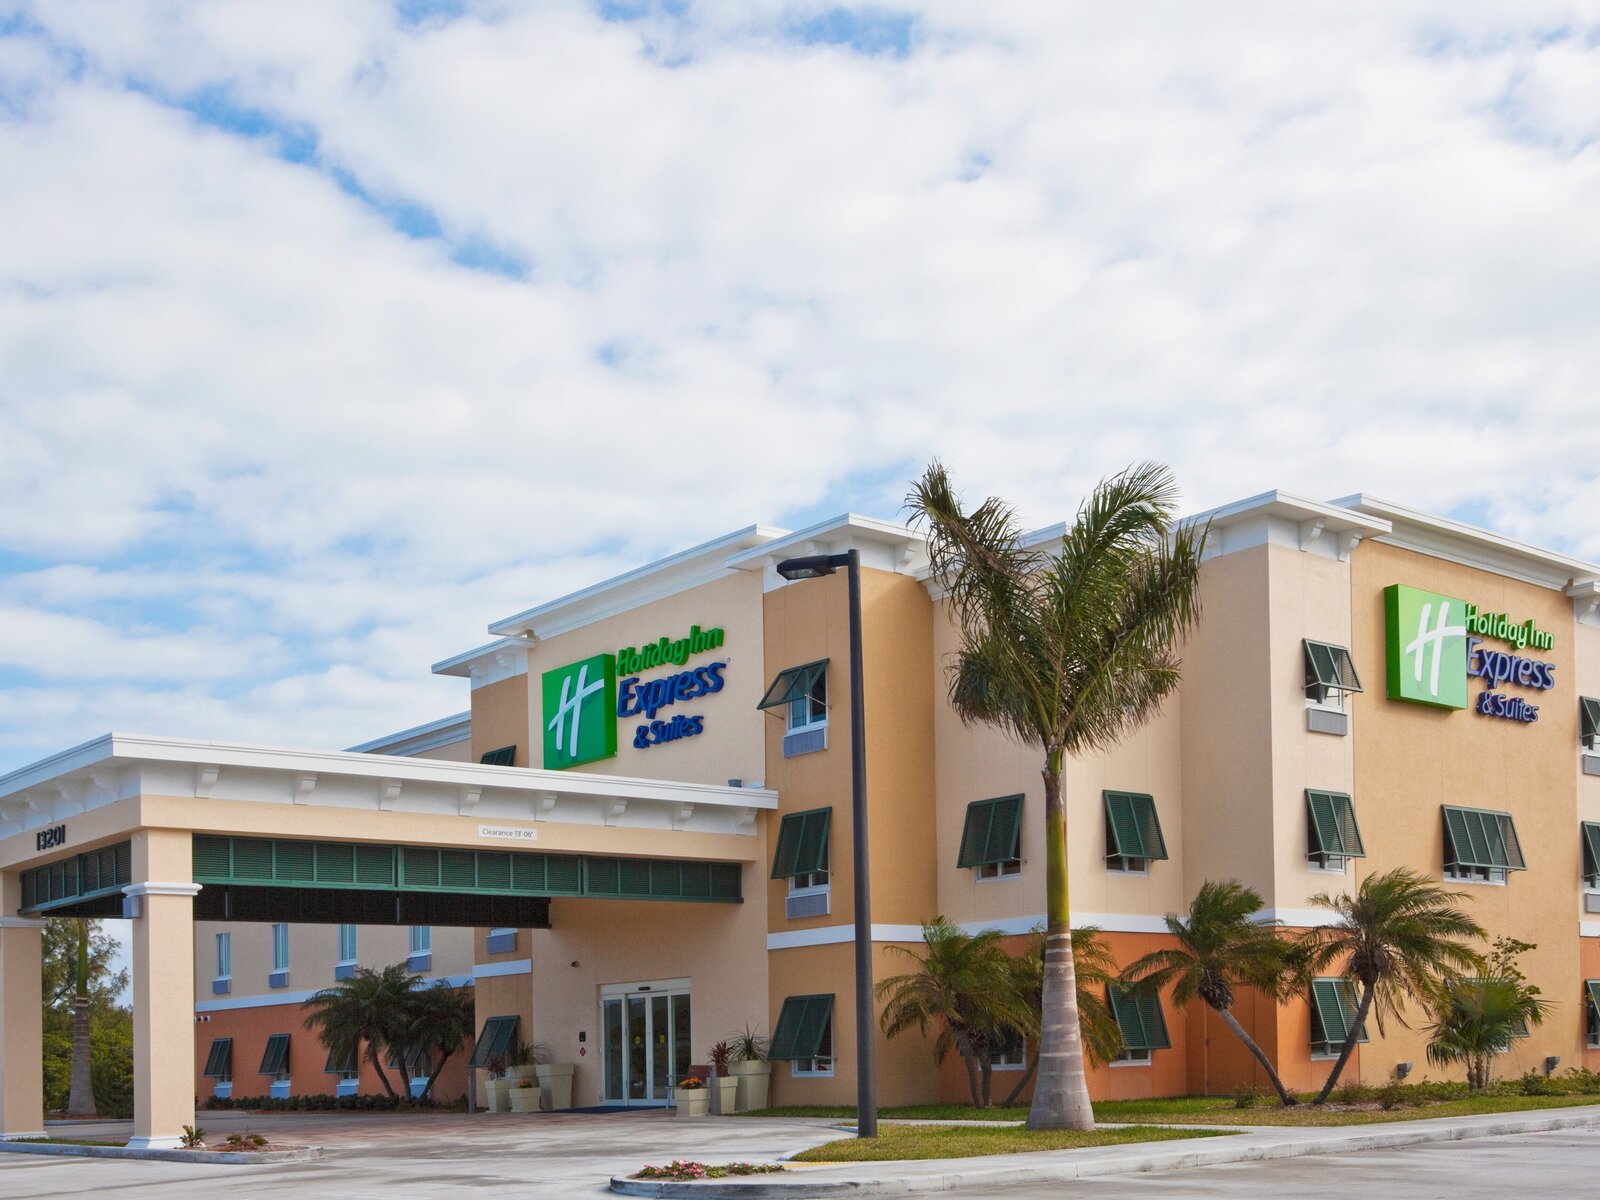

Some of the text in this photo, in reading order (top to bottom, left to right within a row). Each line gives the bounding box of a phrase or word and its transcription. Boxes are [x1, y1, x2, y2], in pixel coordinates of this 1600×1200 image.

[1466, 603, 1555, 651] Holiday Inn
[616, 625, 724, 677] Holiday Inn
[1466, 637, 1556, 691] Express
[617, 661, 727, 720] Express
[1477, 690, 1540, 723] & Suites
[633, 714, 704, 750] & Suites
[36, 824, 66, 851] 13201
[482, 828, 513, 837] Clearance
